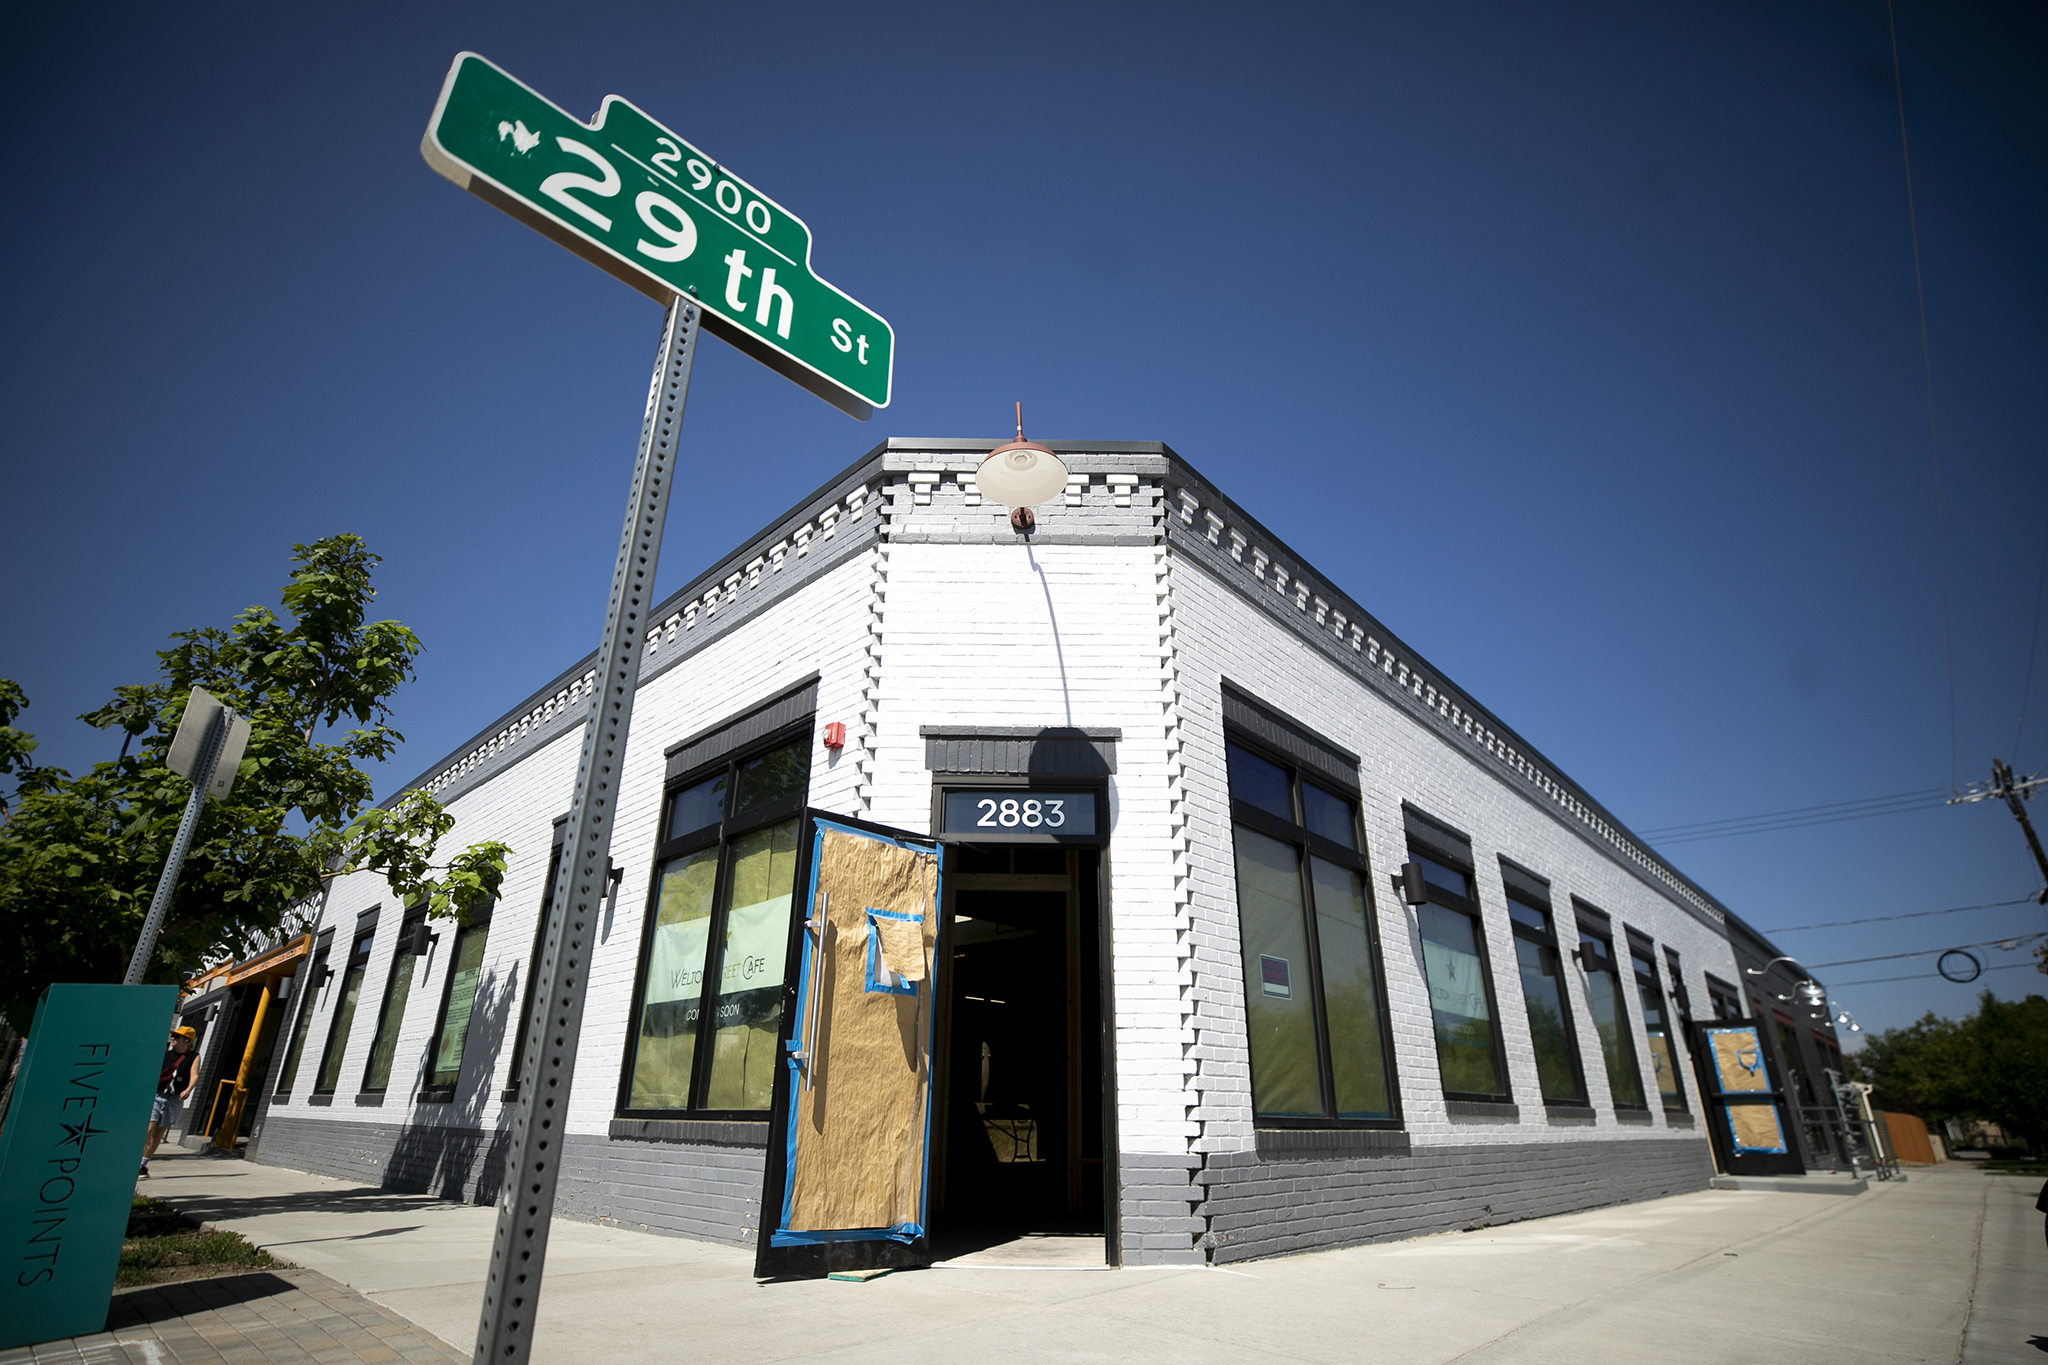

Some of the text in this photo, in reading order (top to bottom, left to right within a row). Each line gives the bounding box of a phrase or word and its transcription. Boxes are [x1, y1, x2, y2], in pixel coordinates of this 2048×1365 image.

[651, 137, 771, 235] 2900
[830, 318, 869, 366] St
[976, 798, 1066, 829] 2883
[670, 970, 704, 989] WELTO
[742, 955, 766, 981] CAFE
[62, 1043, 111, 1112] FIVE
[17, 1156, 81, 1287] POINTS
